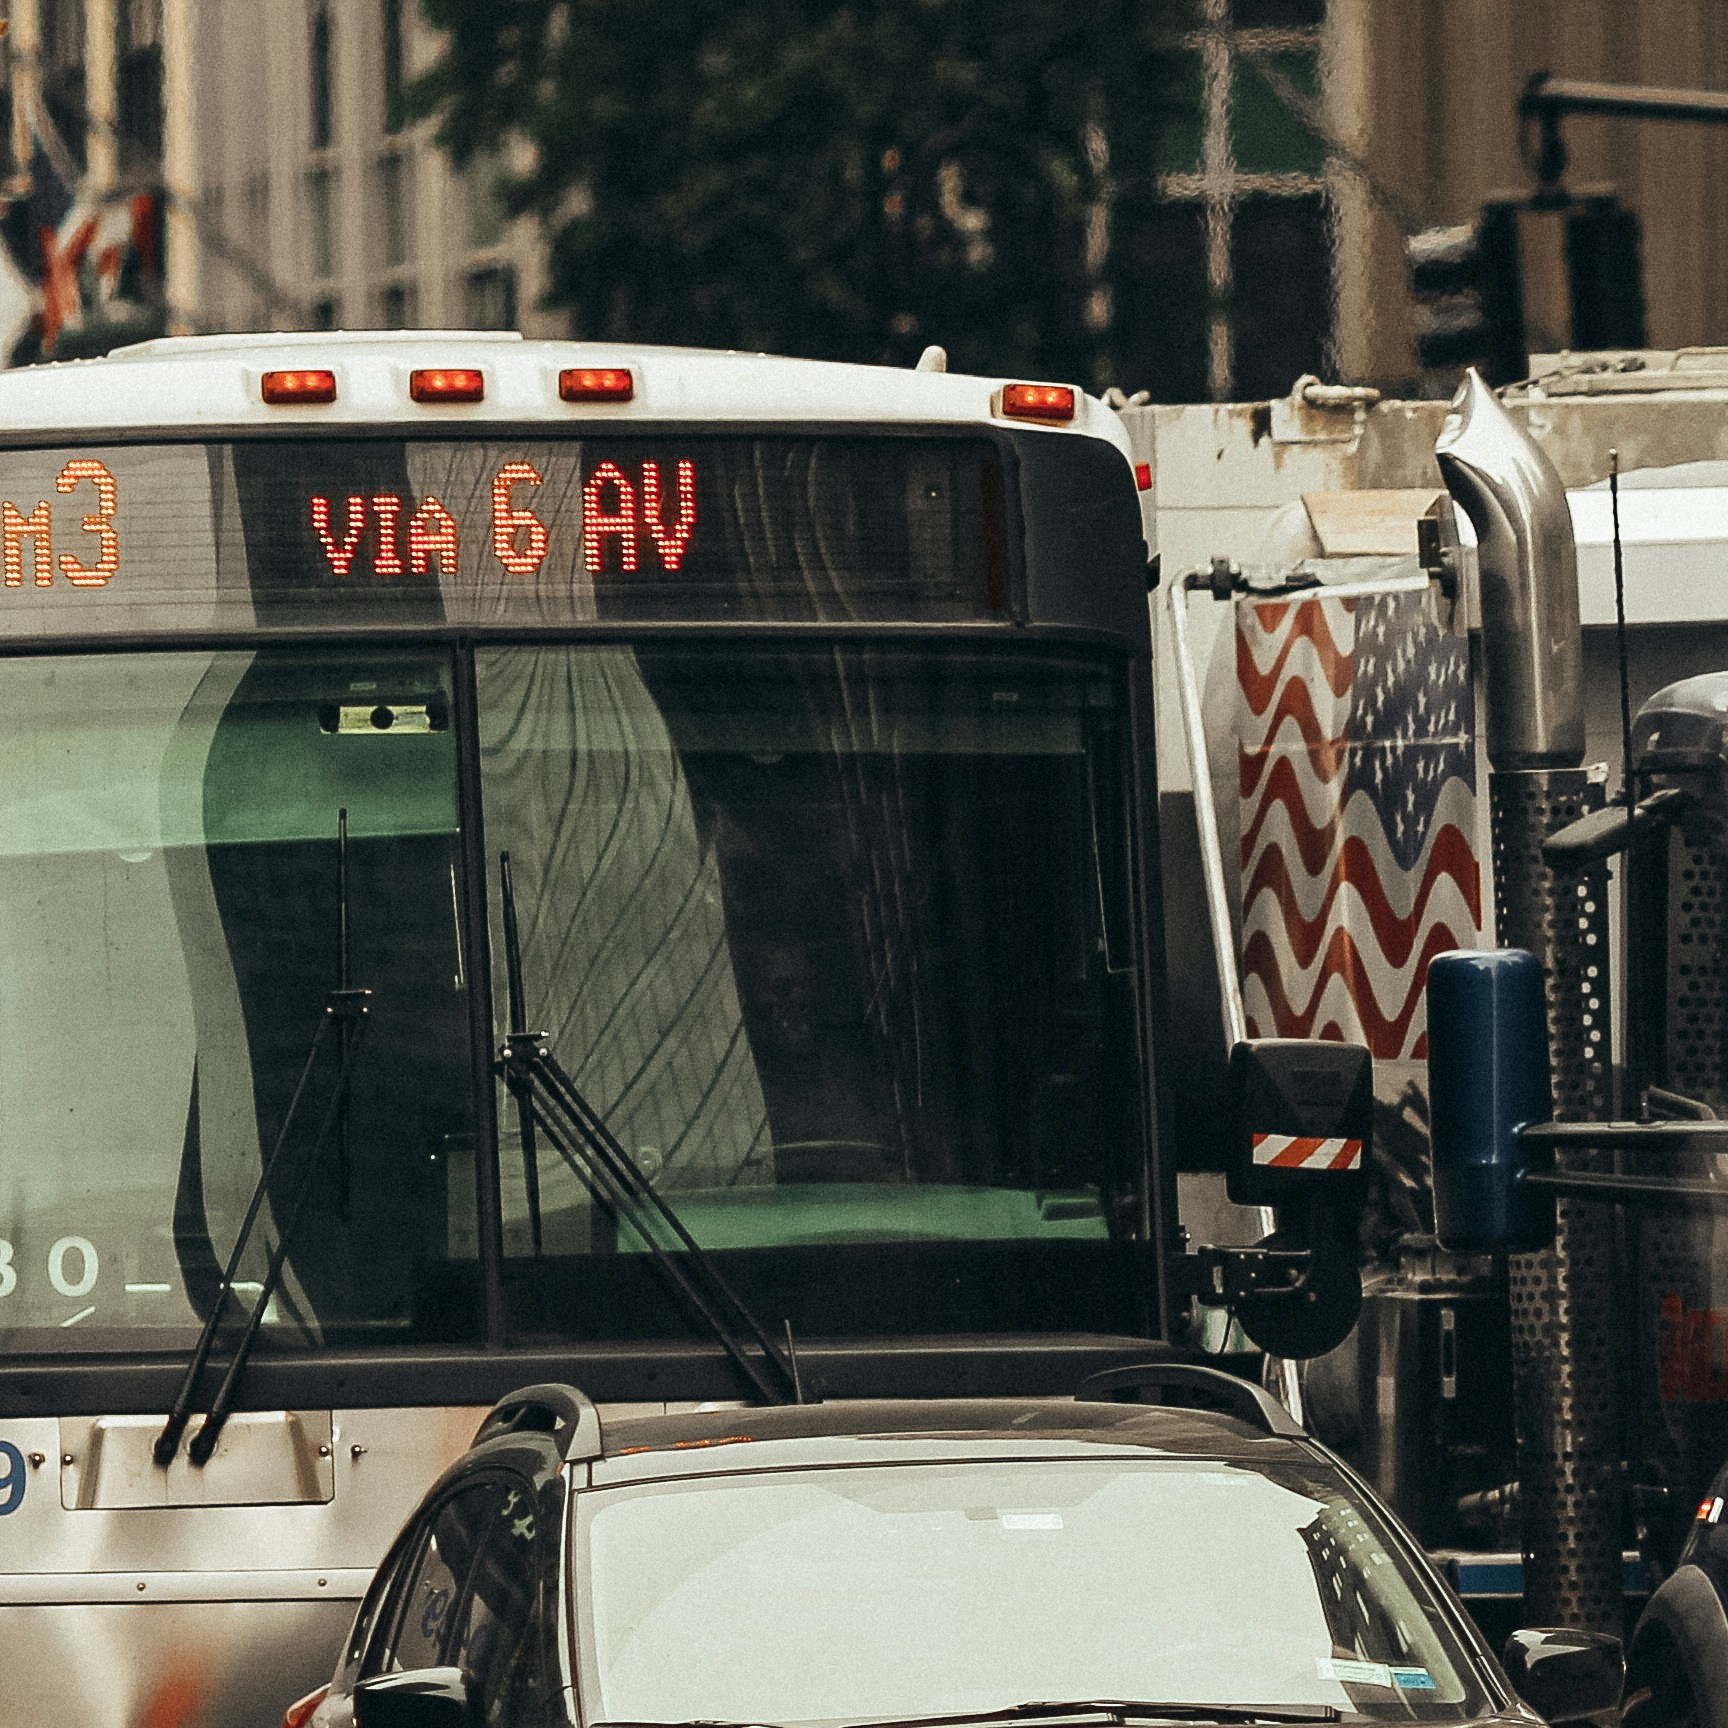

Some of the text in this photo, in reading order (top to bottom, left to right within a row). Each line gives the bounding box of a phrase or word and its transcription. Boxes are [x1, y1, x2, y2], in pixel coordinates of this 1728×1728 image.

[311, 496, 458, 574] VIA
[492, 461, 548, 573] 6
[583, 460, 696, 573] AV
